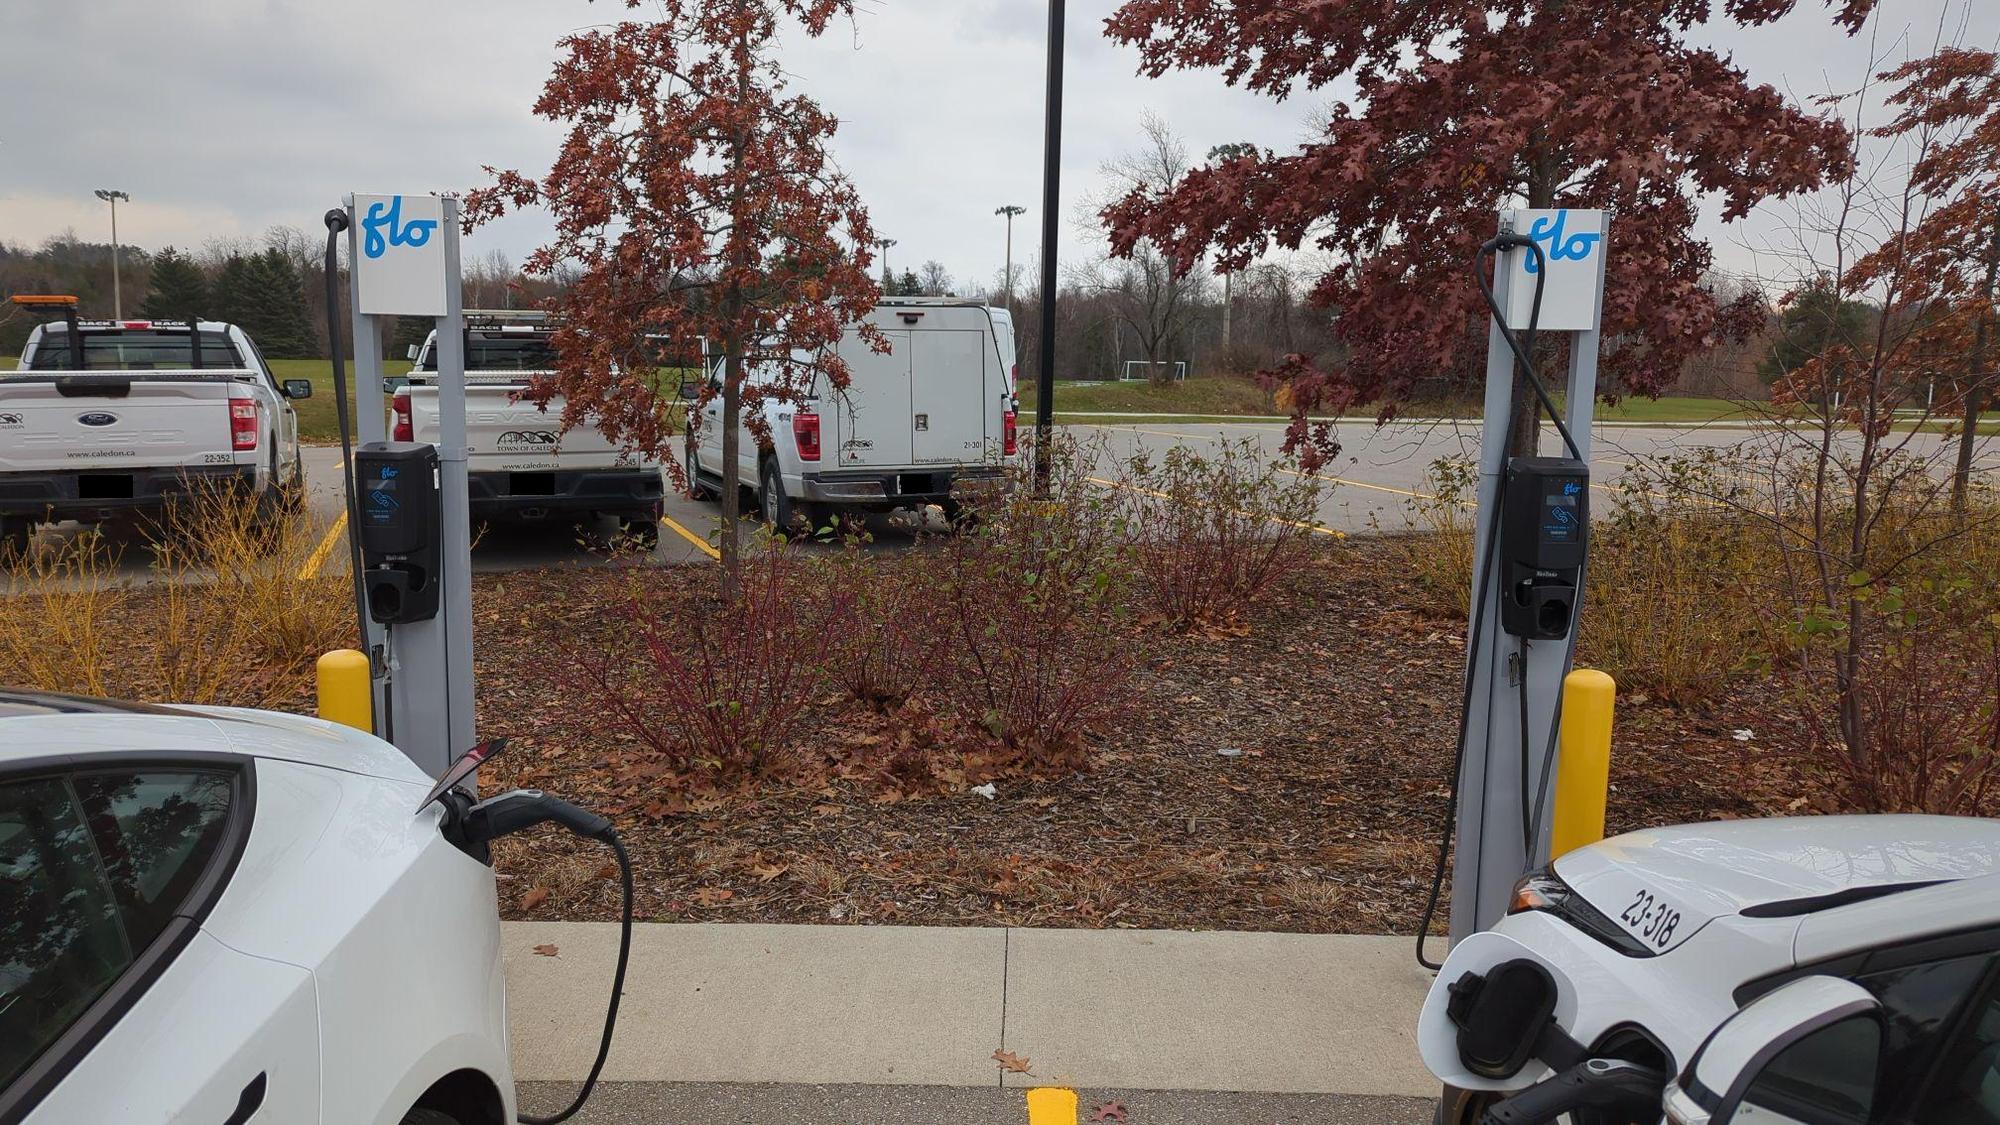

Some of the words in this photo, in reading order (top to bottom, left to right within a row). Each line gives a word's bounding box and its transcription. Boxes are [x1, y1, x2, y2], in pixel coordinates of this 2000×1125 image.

[361, 195, 438, 259] flo
[1524, 208, 1601, 274] flo
[66, 449, 136, 458] www.caledon.ca
[204, 454, 231, 463] 22-352
[381, 466, 399, 480] flo
[502, 462, 560, 470] www.caledon.ca
[1563, 482, 1582, 496] flo
[1620, 889, 1681, 948] 23-318
